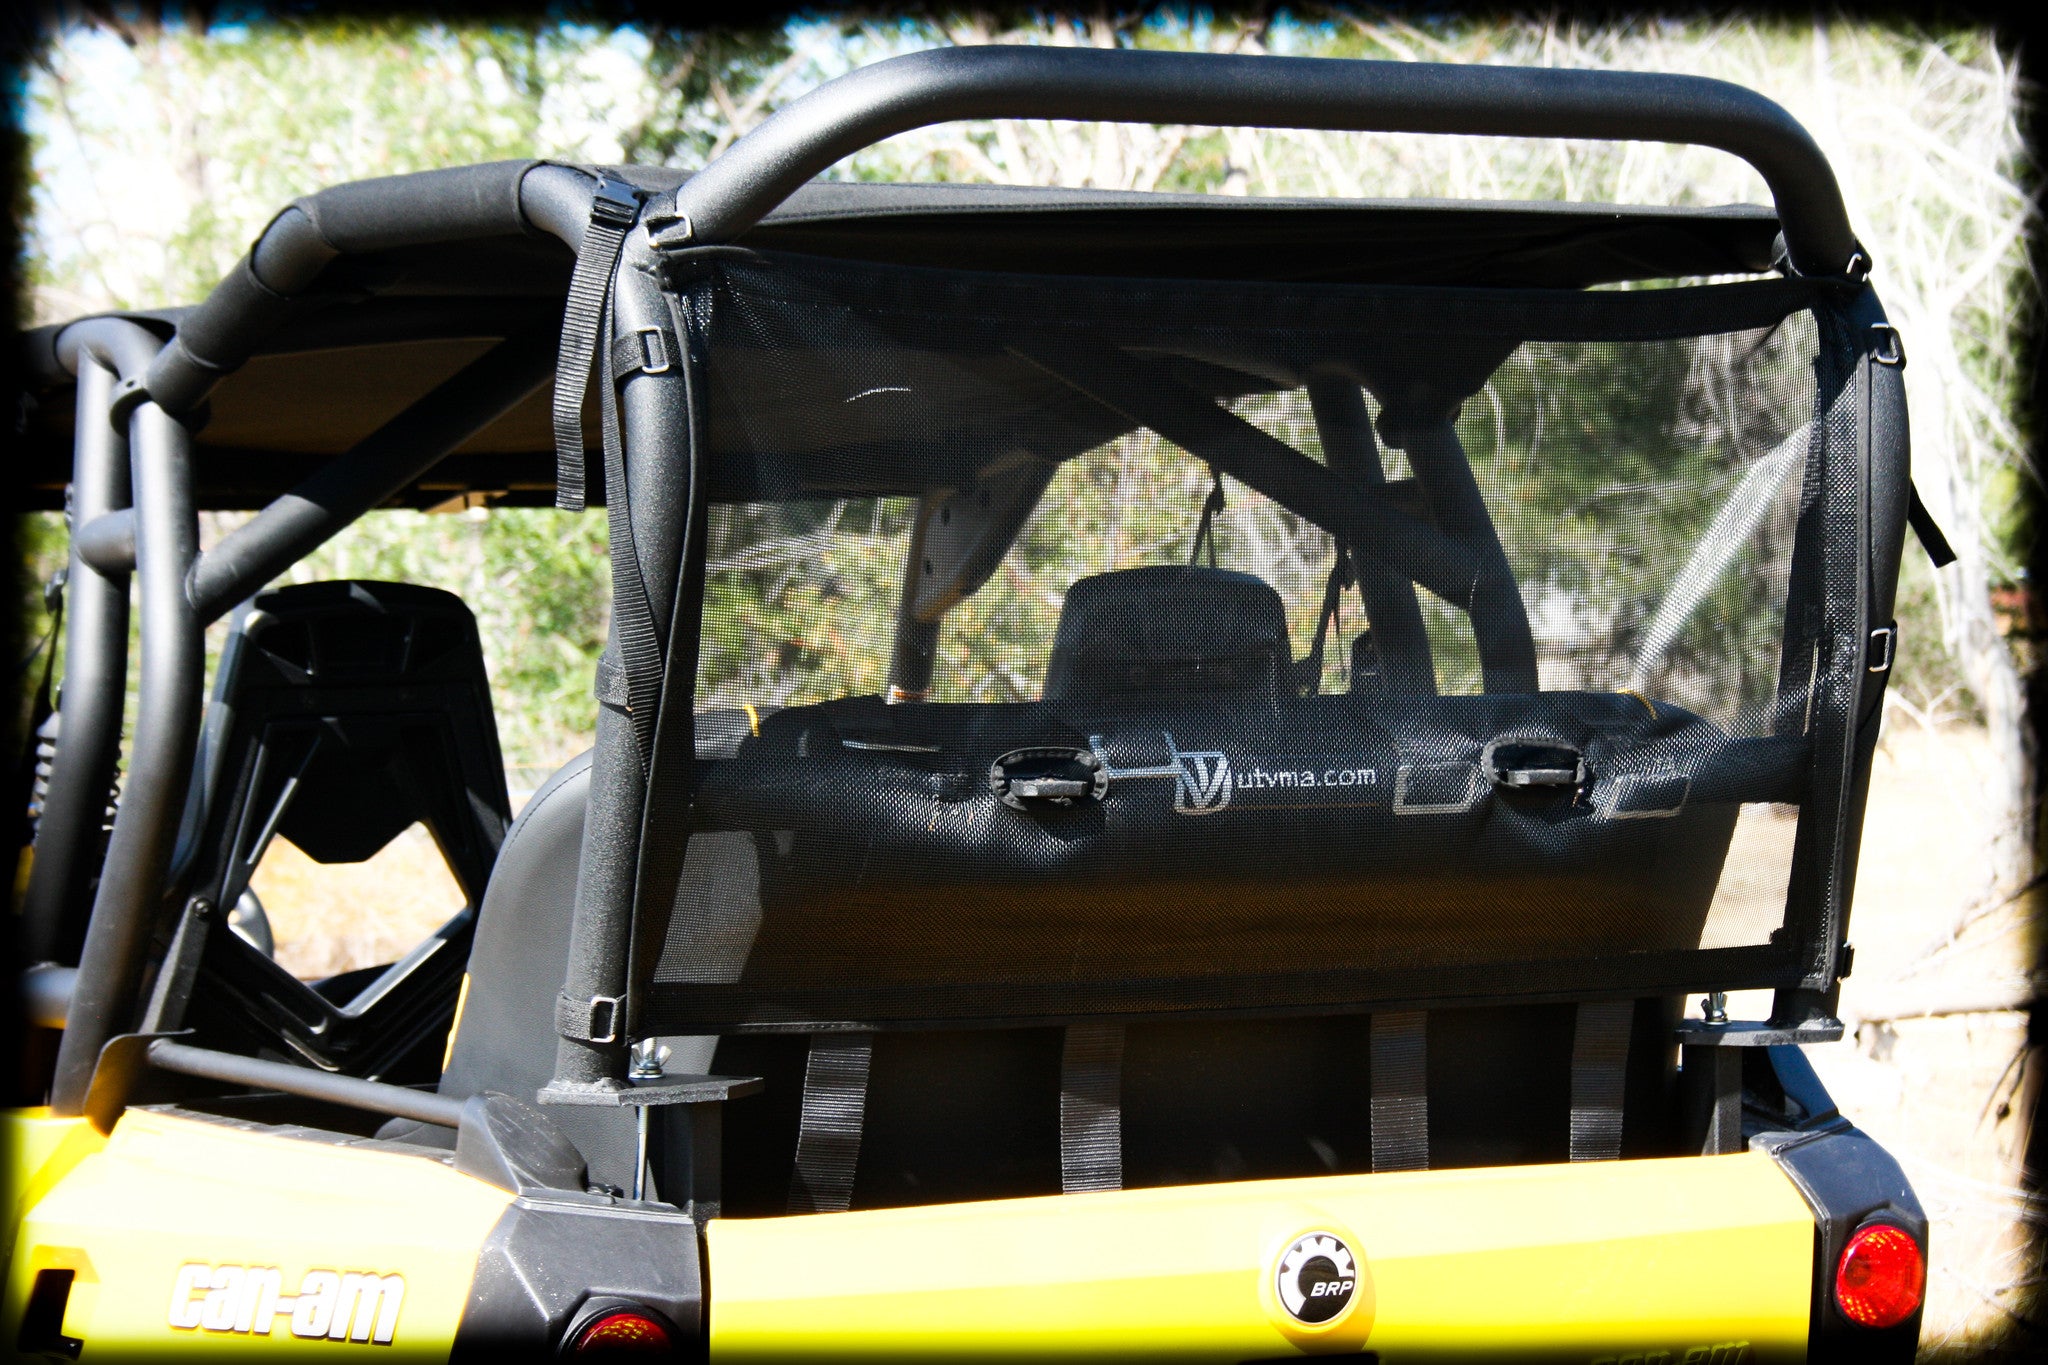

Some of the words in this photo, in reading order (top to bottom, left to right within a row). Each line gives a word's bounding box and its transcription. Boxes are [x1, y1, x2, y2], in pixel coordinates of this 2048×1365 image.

[1236, 767, 1378, 789] utvma.com
[1310, 1281, 1354, 1297] BRP
[168, 1262, 405, 1346] can-am
